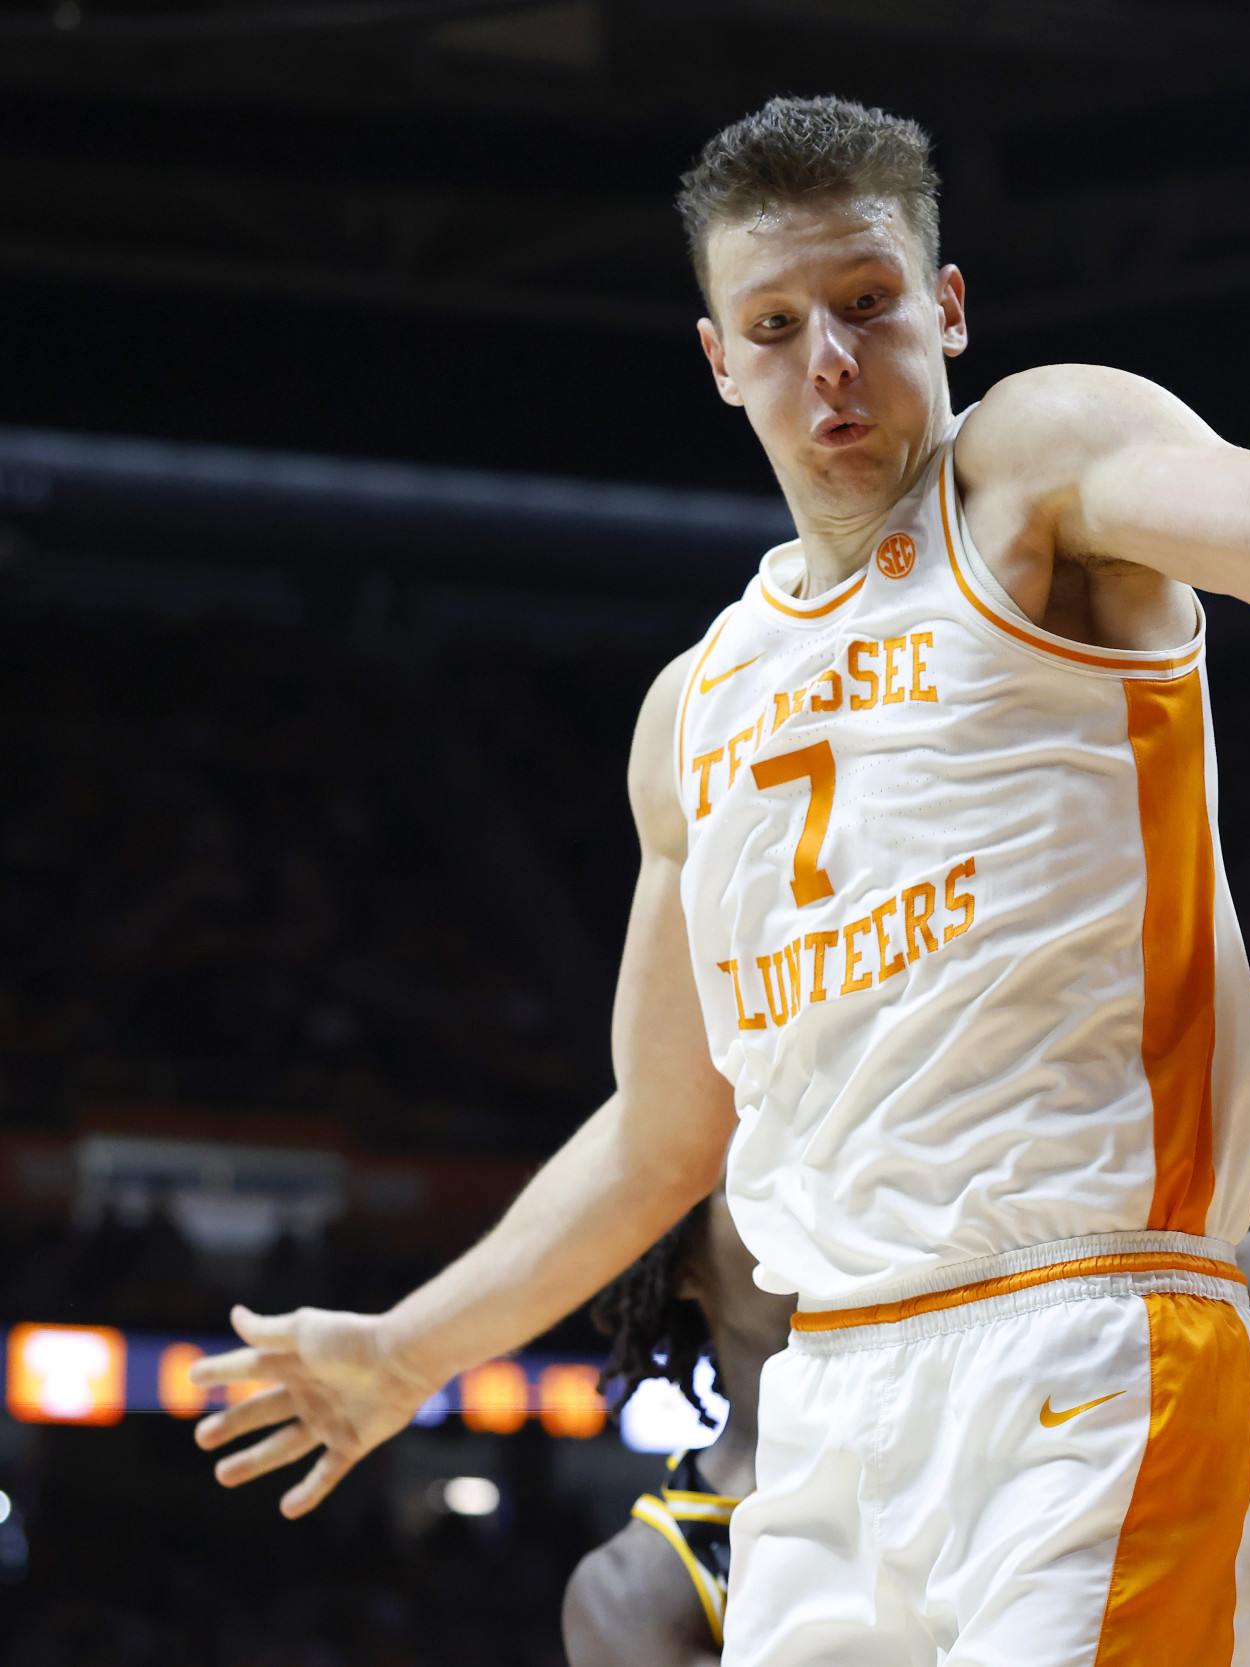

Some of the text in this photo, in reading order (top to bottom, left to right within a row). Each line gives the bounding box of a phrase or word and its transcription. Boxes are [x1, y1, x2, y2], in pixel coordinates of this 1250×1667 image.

[879, 536, 913, 575] SEC
[692, 632, 939, 821] TENSSEE
[750, 739, 836, 909] 7
